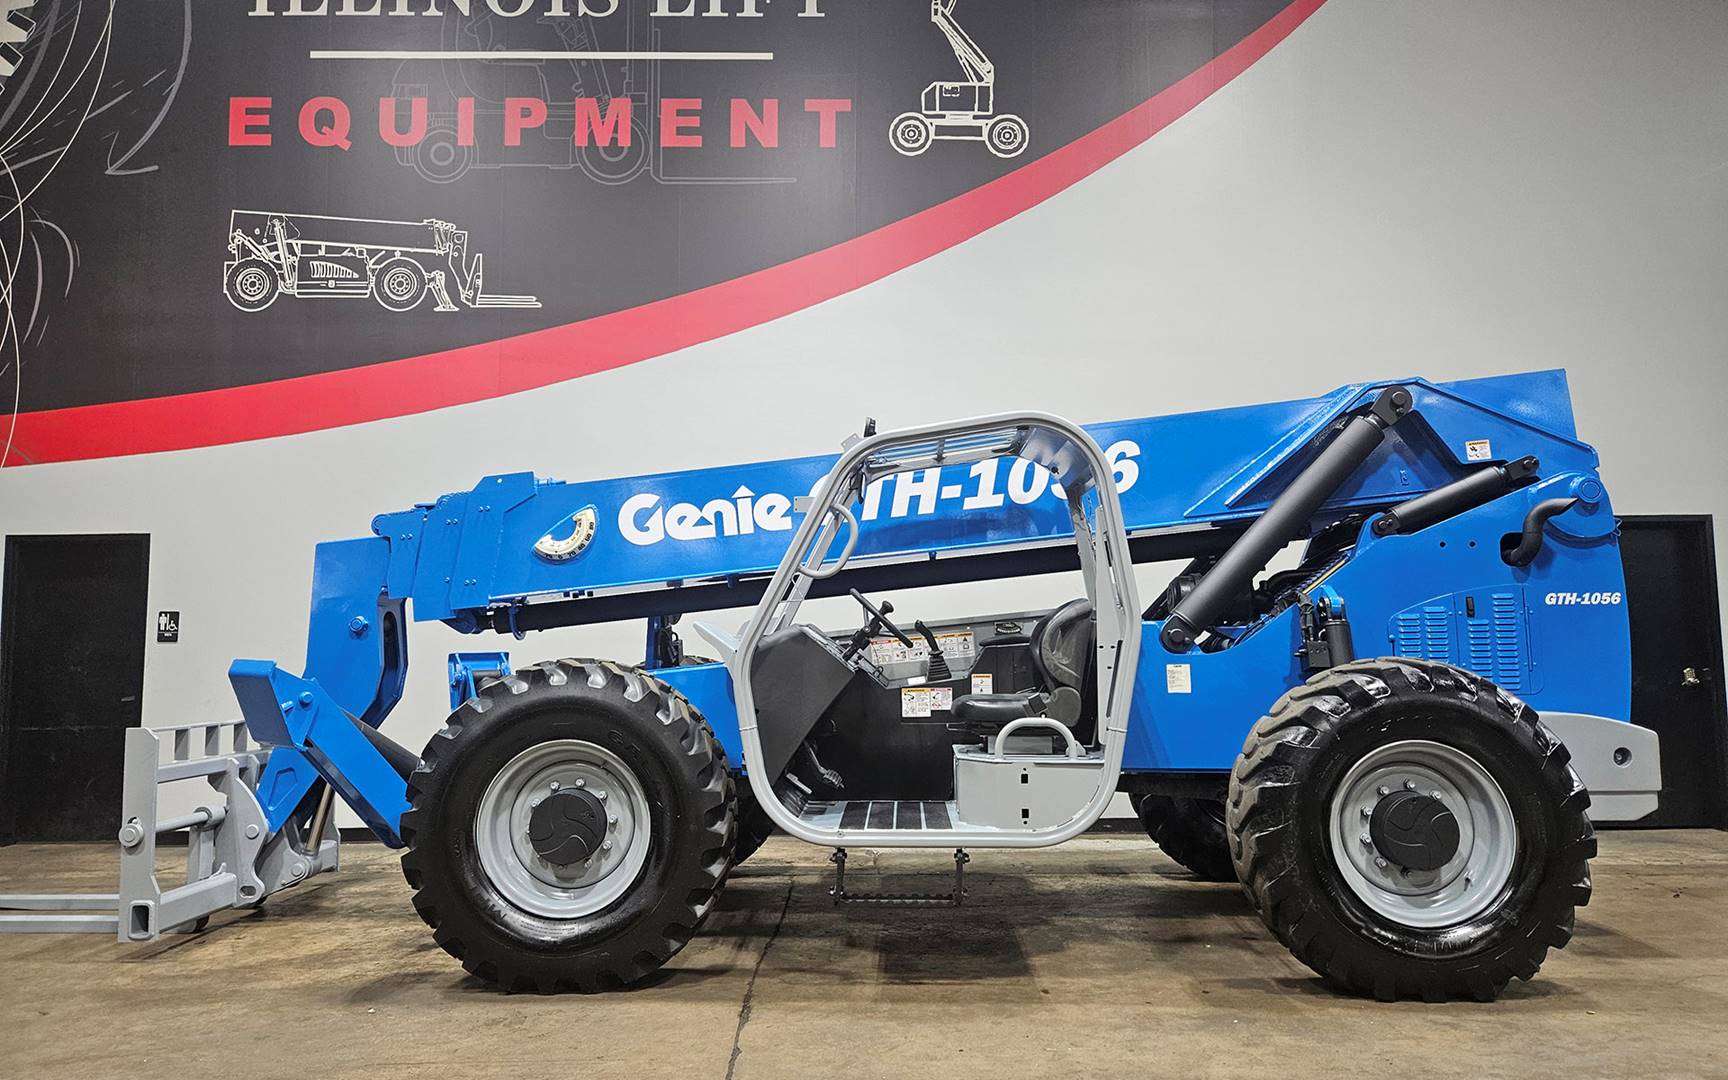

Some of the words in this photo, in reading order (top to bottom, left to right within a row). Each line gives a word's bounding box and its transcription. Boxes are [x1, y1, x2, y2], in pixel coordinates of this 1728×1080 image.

[228, 96, 851, 150] EQUIPMENT
[618, 485, 793, 545] Genie
[808, 440, 1141, 526] TH-106
[1544, 592, 1622, 605] GTH-1056
